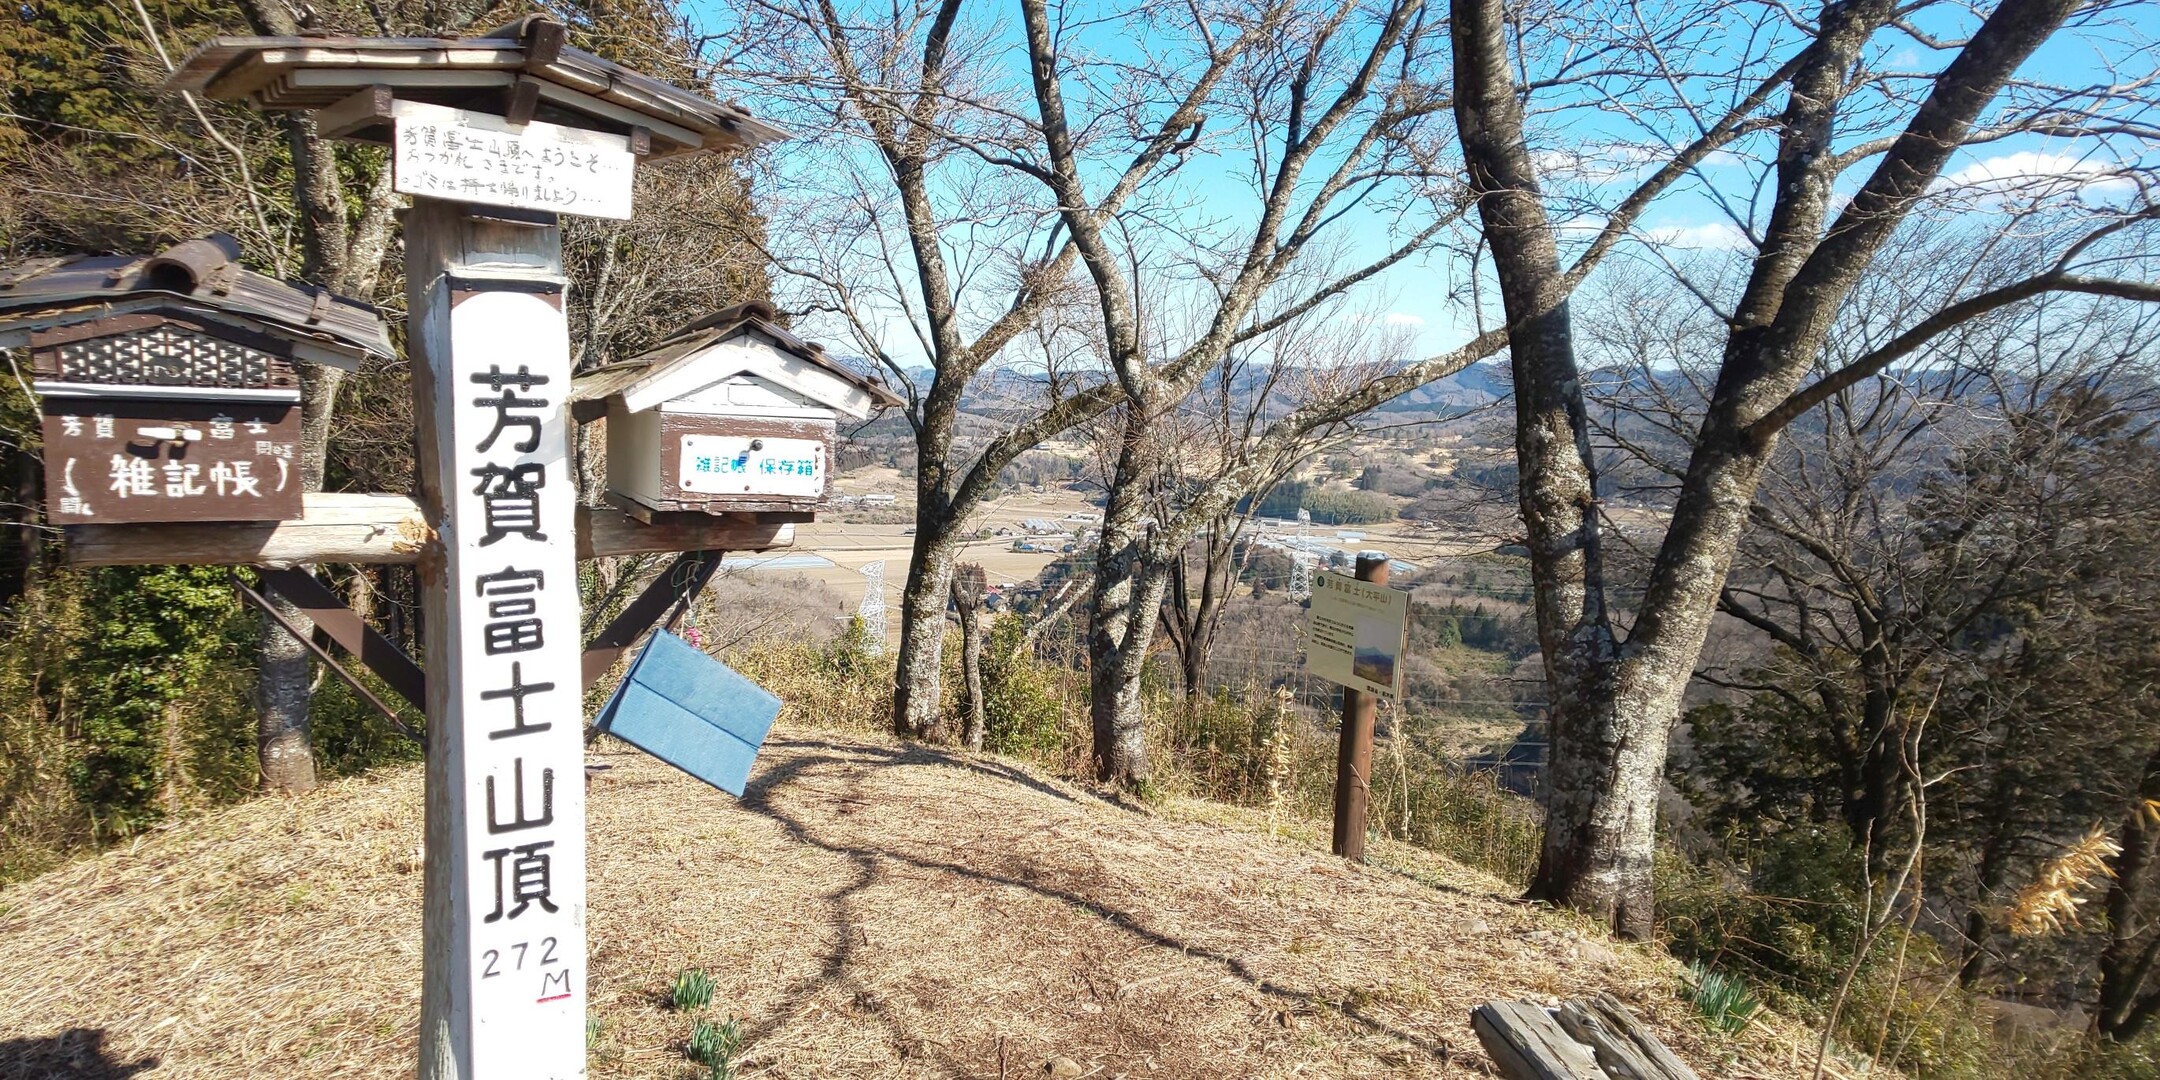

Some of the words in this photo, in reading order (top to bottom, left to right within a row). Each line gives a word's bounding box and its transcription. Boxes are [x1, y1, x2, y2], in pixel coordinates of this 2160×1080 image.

[470, 363, 560, 925] 芳賀富士山頂
[480, 935, 560, 980] 272
[542, 969, 571, 996] M
